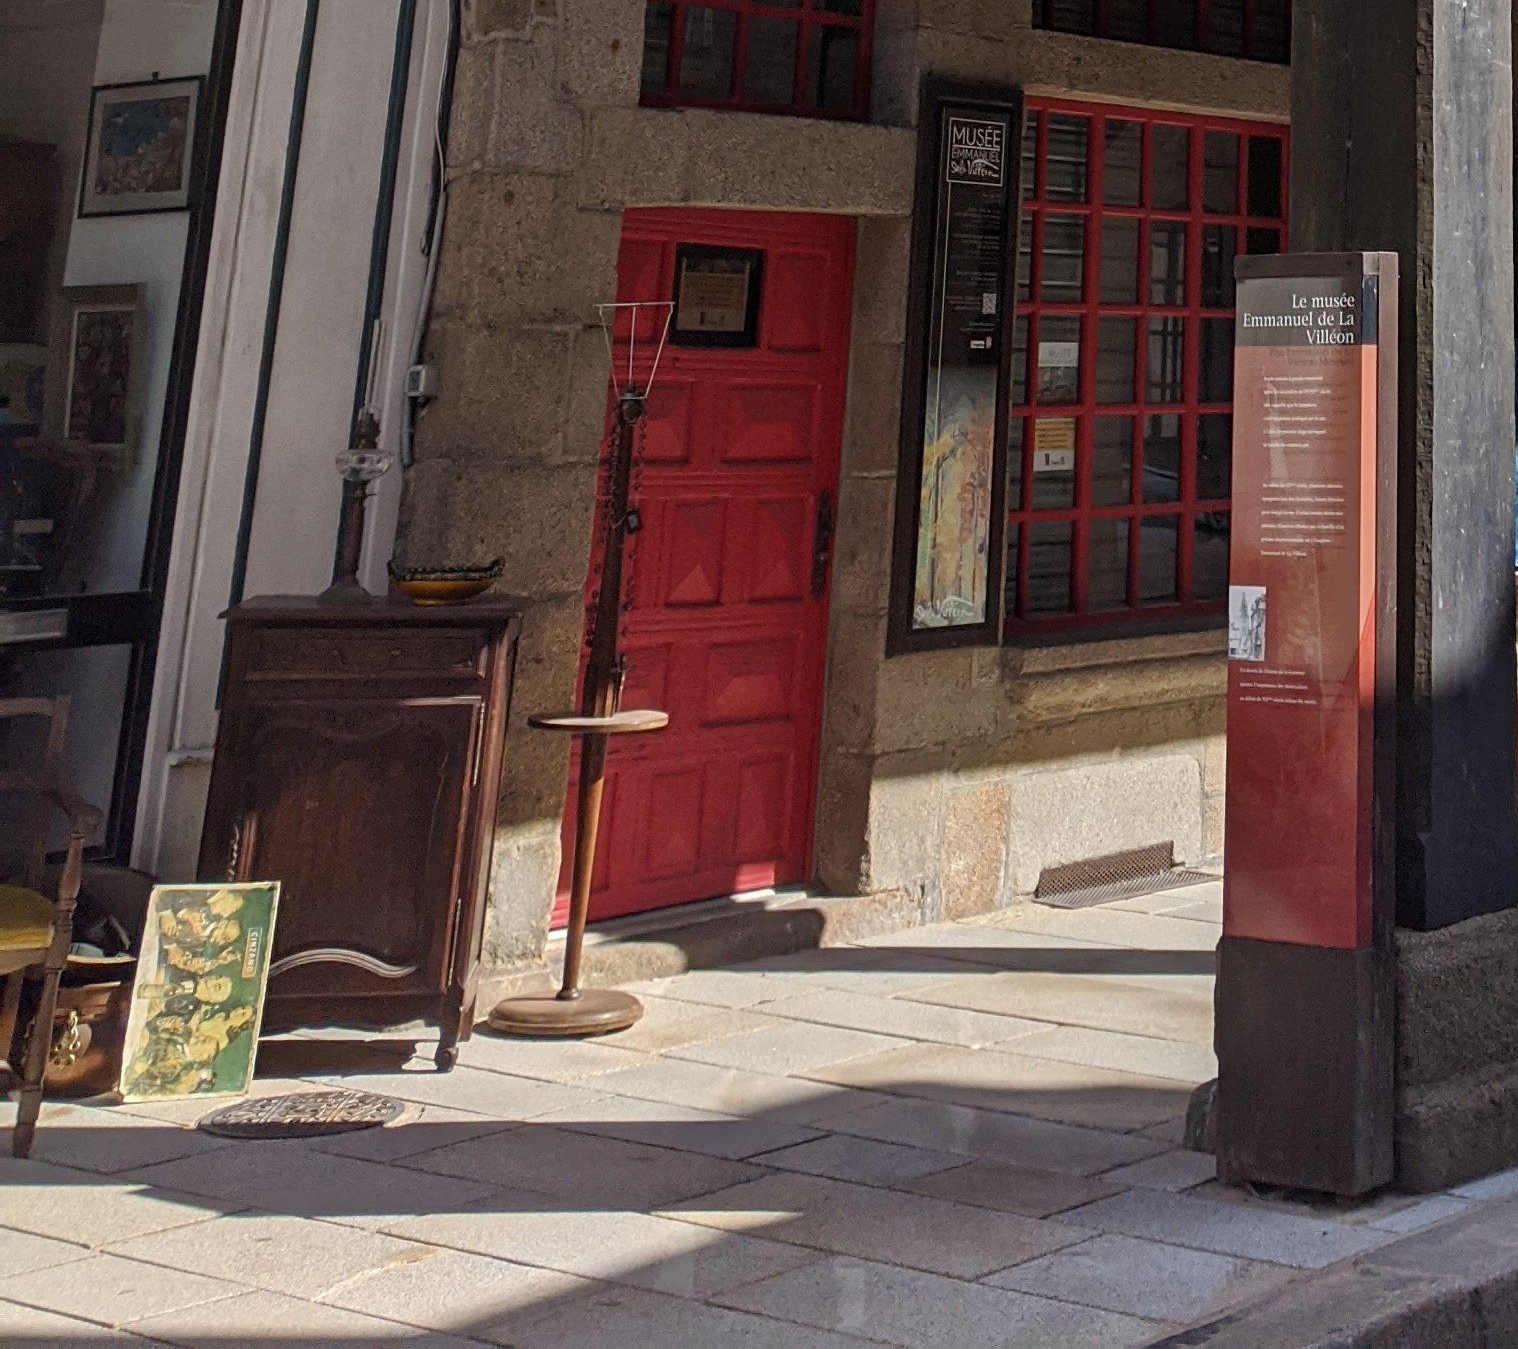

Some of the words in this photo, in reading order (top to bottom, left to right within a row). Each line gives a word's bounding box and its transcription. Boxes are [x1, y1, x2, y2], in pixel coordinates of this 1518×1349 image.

[952, 124, 1001, 149] MUSÉE
[951, 146, 1001, 163] EMMANUEL
[1291, 293, 1308, 309] Le
[1311, 292, 1356, 309] musée
[1243, 311, 1313, 328] Emmanuel
[1317, 311, 1335, 327] de
[1338, 310, 1355, 327] La
[1305, 328, 1355, 345] Villéon
[246, 932, 258, 972] CINZANO
